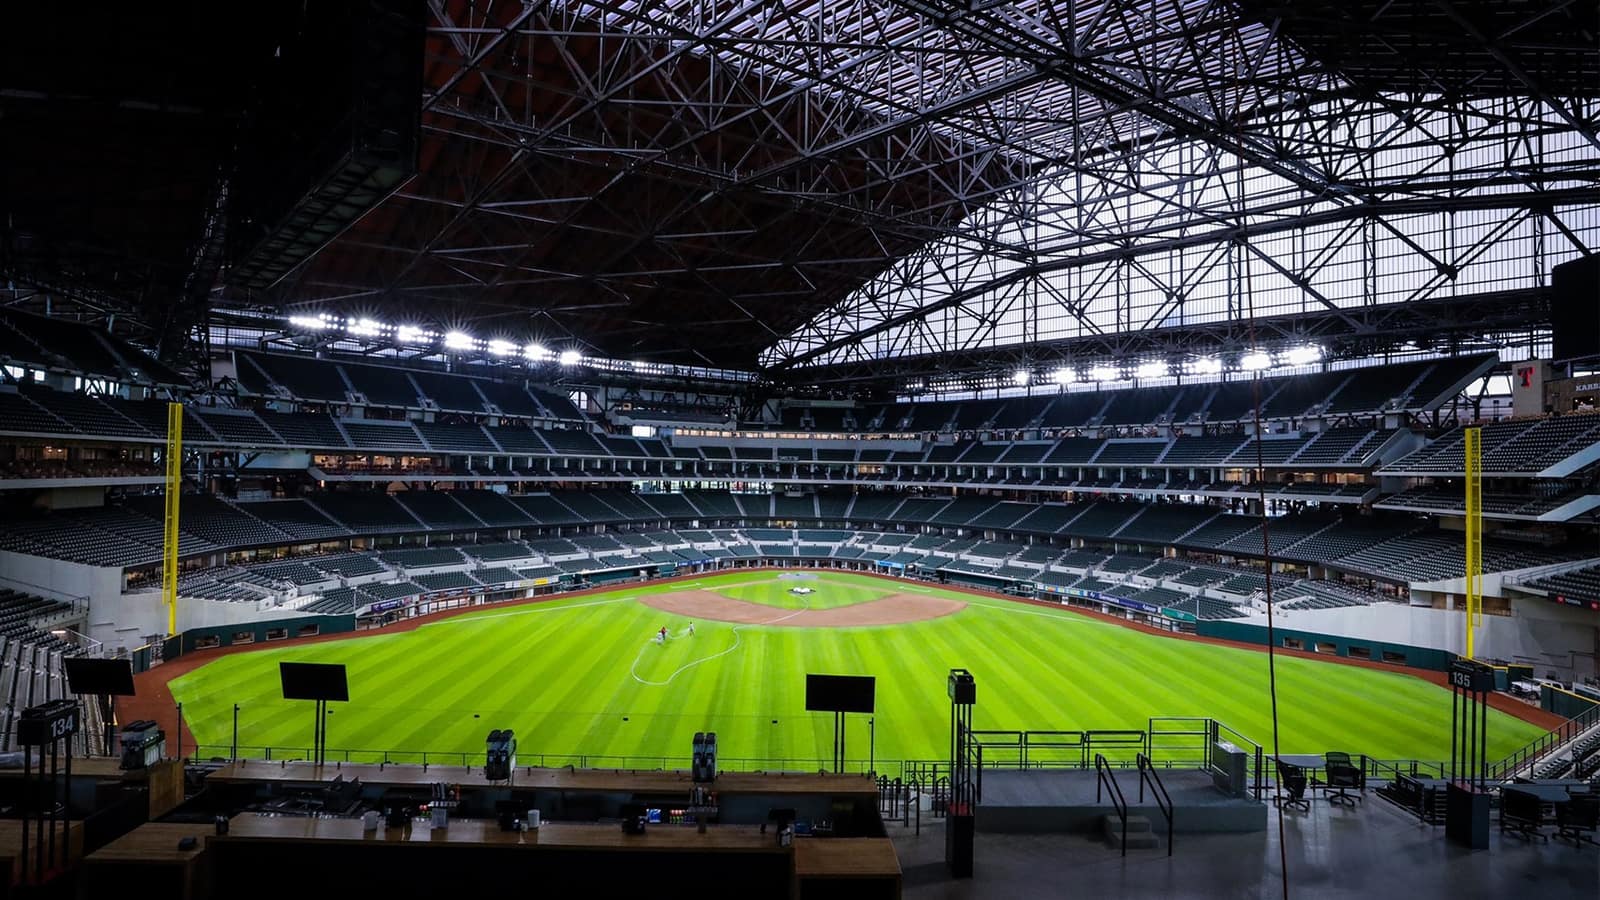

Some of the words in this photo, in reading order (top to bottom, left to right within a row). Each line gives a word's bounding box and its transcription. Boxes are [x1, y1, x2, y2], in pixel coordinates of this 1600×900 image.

[1518, 366, 1534, 388] T
[1576, 383, 1600, 392] KARB
[1453, 672, 1470, 687] 135
[51, 715, 73, 737] 134
